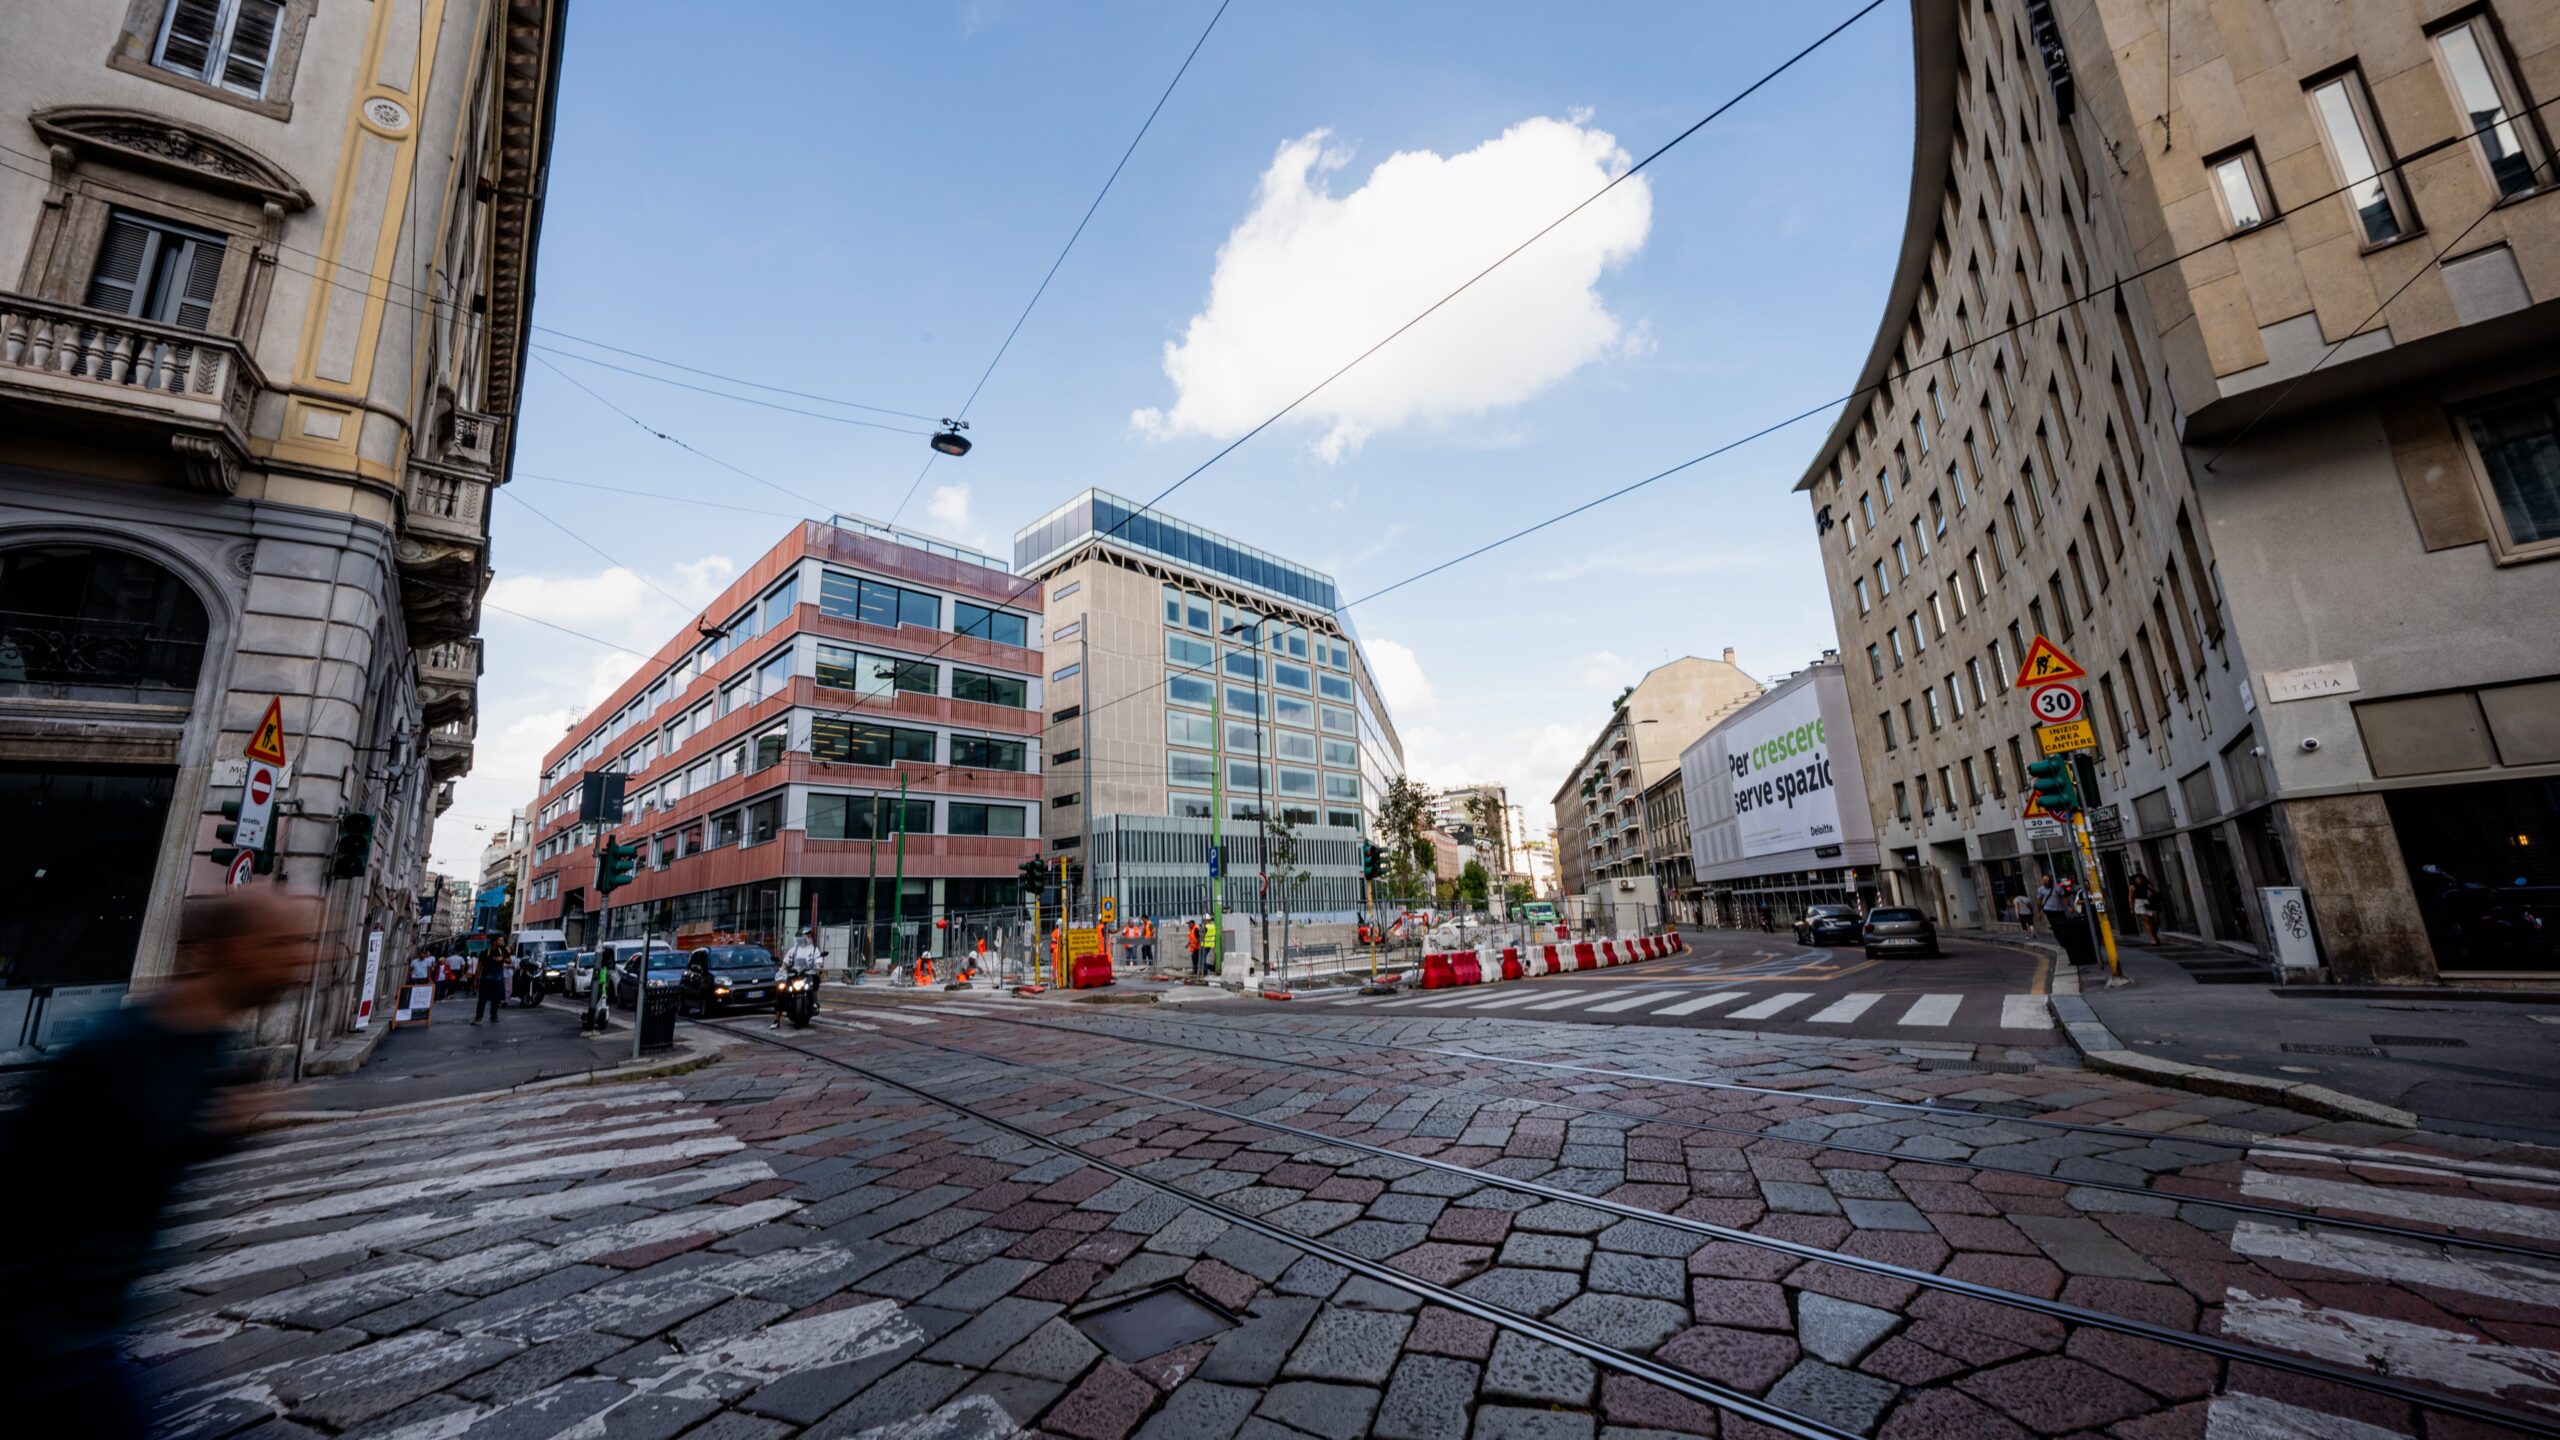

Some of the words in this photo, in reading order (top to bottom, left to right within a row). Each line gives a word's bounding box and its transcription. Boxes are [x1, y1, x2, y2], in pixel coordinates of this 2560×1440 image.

[2283, 679, 2342, 693] ITALIA
[2042, 693, 2071, 713] 30
[2049, 724, 2079, 735] INIZIO
[2044, 737, 2093, 752] CANTIERE
[2054, 732, 2080, 743] AREA
[1728, 752, 1749, 781] Per
[1752, 718, 1826, 771] crescere
[1211, 849, 1217, 864] P
